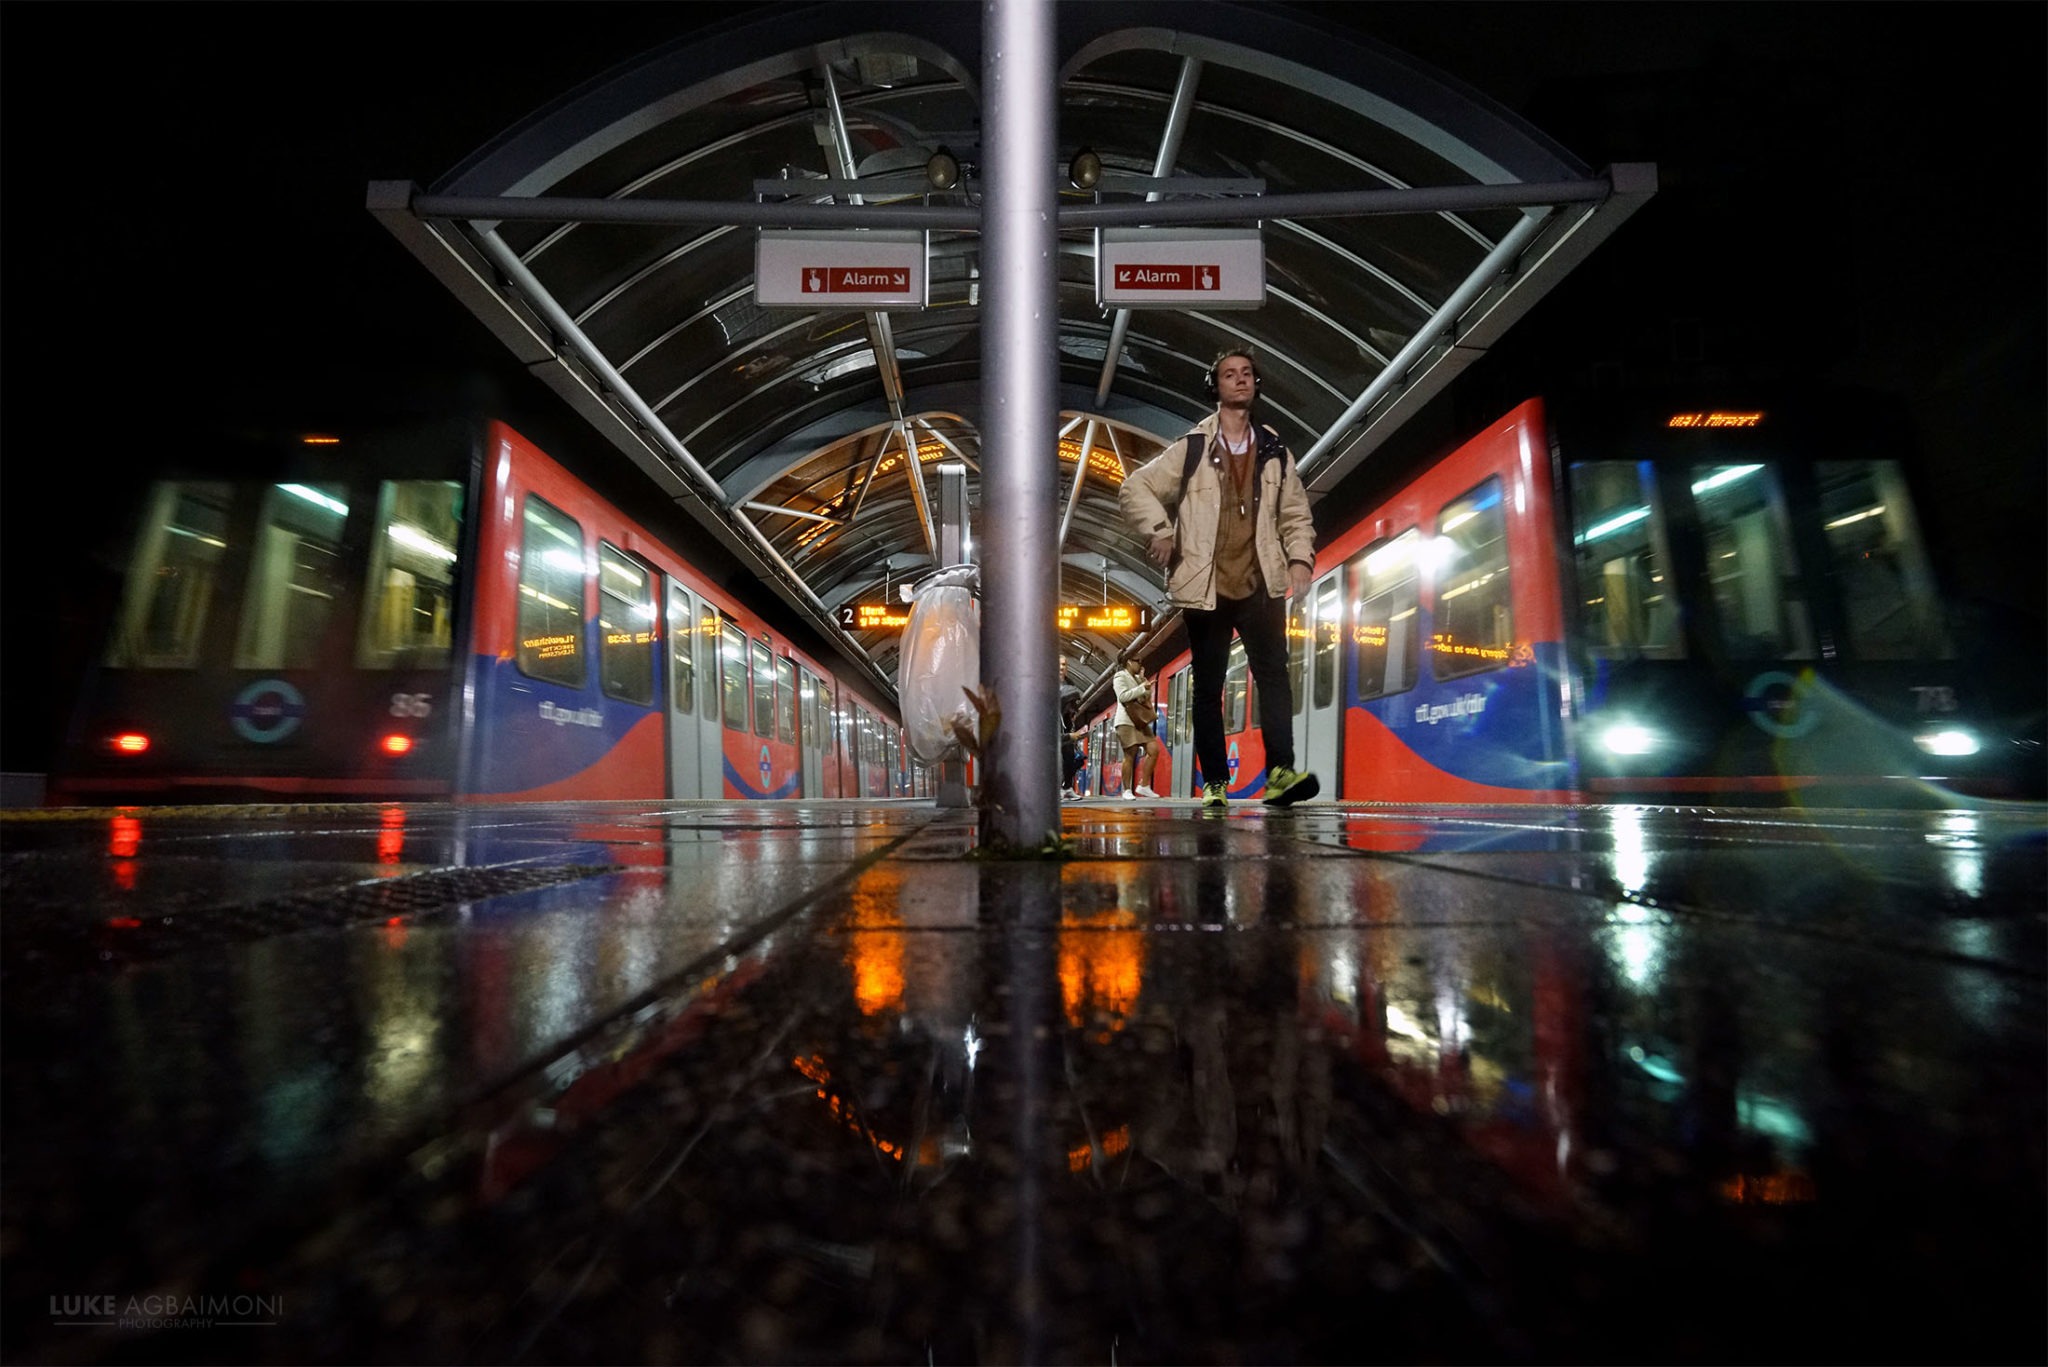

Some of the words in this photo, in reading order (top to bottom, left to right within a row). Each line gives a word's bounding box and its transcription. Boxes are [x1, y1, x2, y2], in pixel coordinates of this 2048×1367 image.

[842, 272, 889, 286] Alarm
[1134, 269, 1181, 283] Alarm
[843, 608, 854, 623] 2
